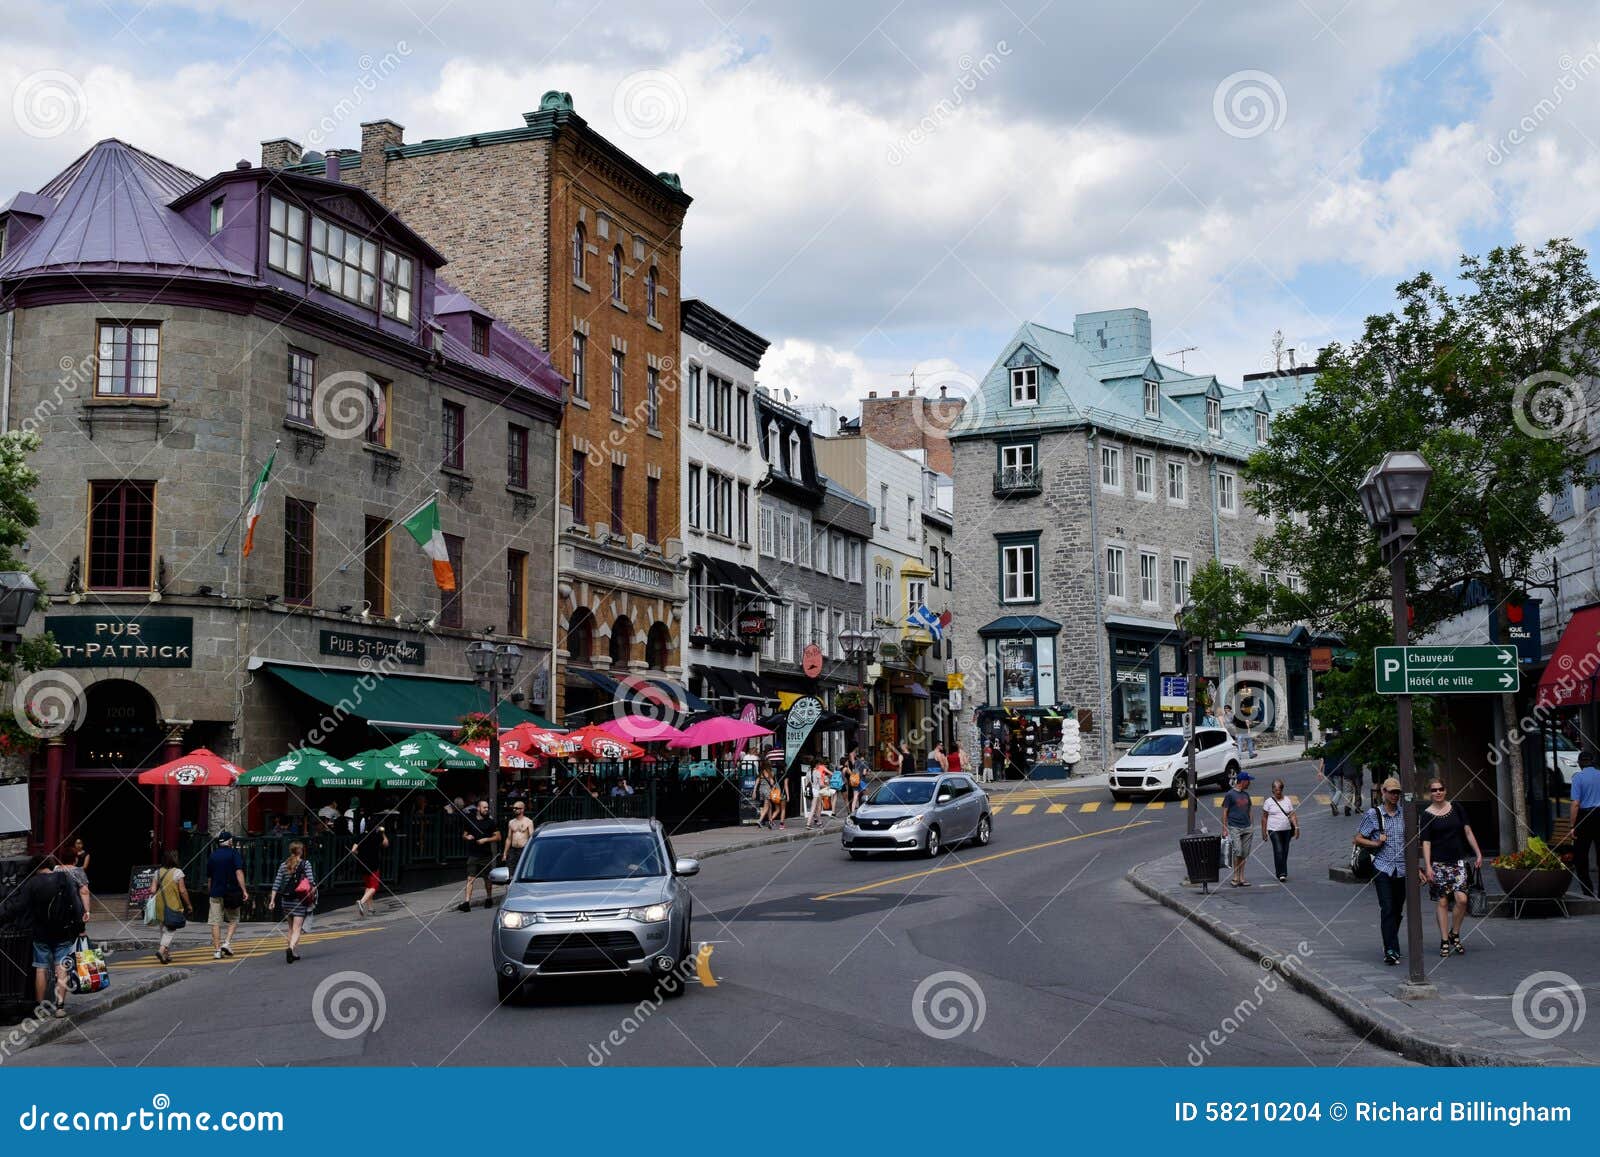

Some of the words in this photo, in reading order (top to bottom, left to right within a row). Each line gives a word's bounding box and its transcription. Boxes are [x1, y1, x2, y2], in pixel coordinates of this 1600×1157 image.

[95, 623, 141, 636] PUB
[1214, 641, 1246, 649] SAKS
[1408, 654, 1454, 663] Chauveau
[1384, 659, 1400, 681] P
[1116, 672, 1147, 683] SAKS
[1409, 676, 1434, 686] Hôtel
[1438, 676, 1449, 686] de
[1453, 676, 1474, 686] ville
